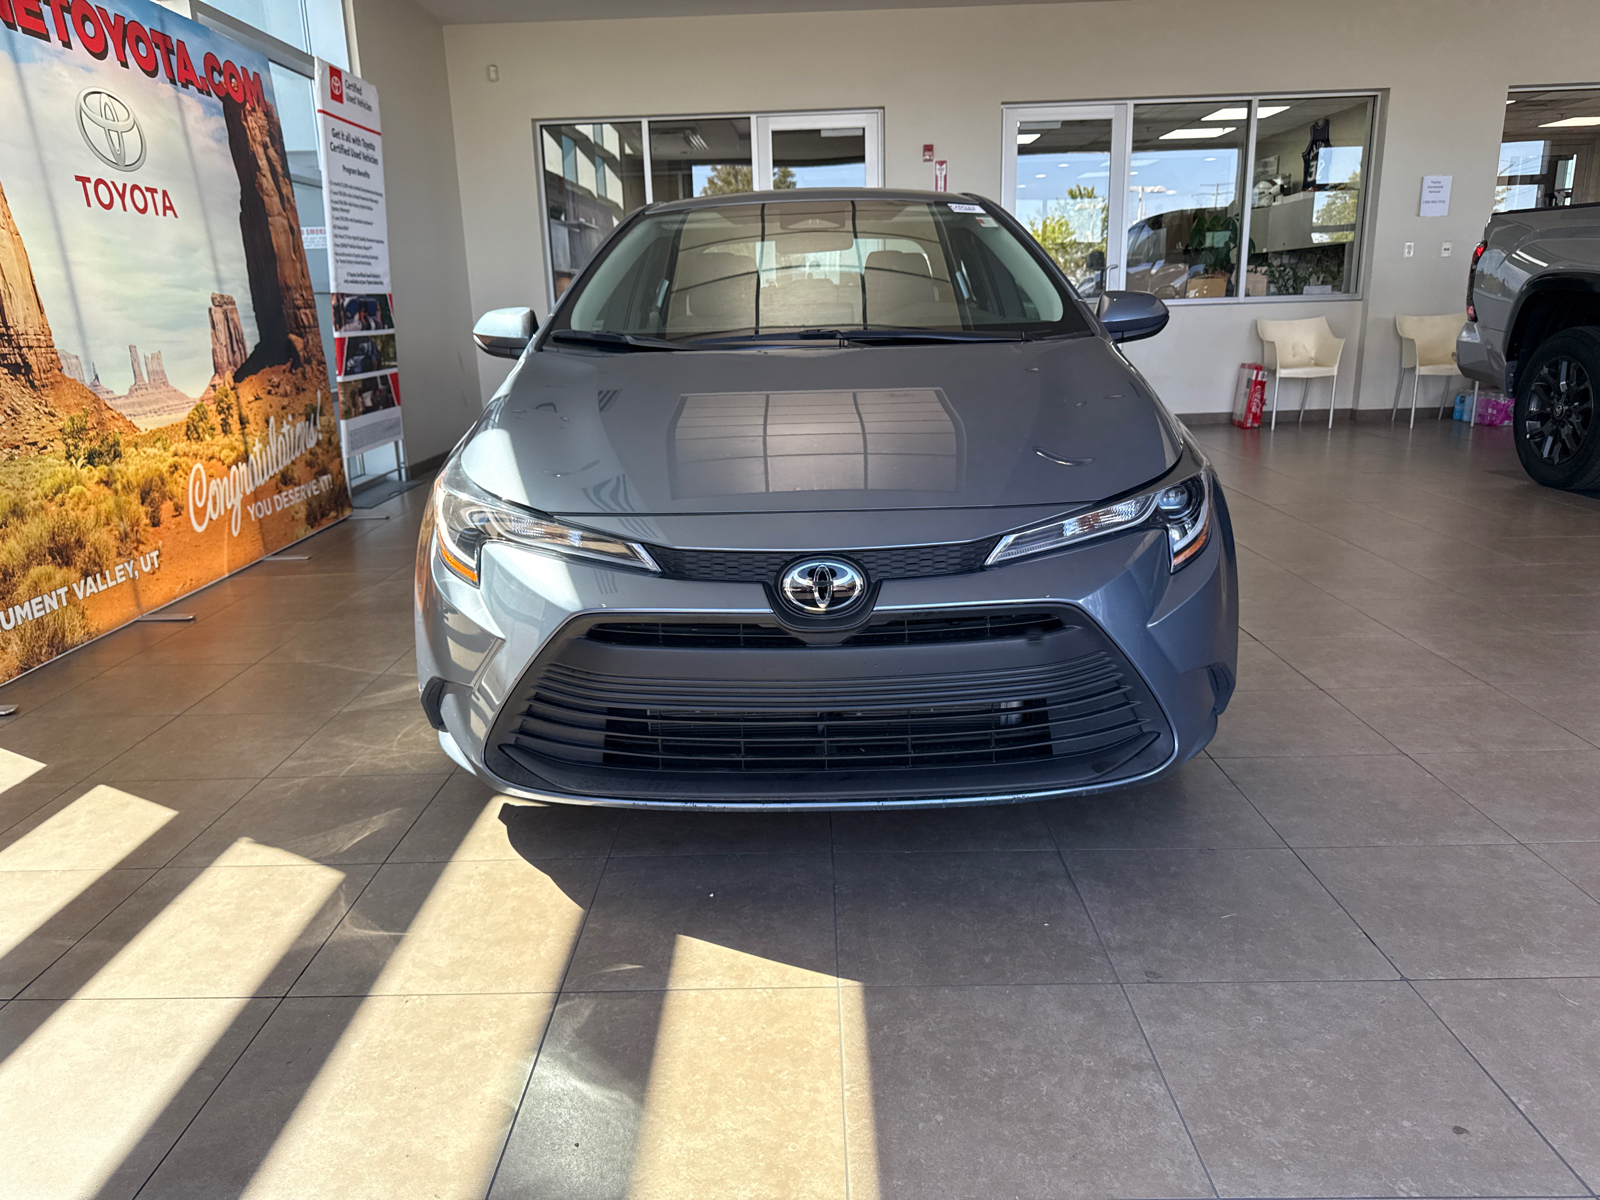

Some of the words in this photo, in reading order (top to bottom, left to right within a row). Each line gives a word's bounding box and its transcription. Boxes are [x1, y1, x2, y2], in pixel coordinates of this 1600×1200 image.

[344, 79, 362, 96] Certified
[346, 92, 357, 105] Used
[357, 98, 373, 113] Vehicles
[329, 141, 350, 157] Certified
[351, 147, 362, 160] Used
[362, 151, 379, 165] Vehicles
[331, 127, 341, 140] Get
[352, 134, 361, 147] with
[361, 138, 376, 152] Toyota
[74, 174, 179, 219] TOYOTA
[188, 389, 323, 537] Congratulations!
[247, 501, 273, 522] YOU
[273, 480, 320, 512] DESERVE
[319, 474, 334, 492] IT!
[0, 586, 69, 634] UMENT
[71, 559, 139, 600] VALLEY,
[140, 550, 160, 573] UT
